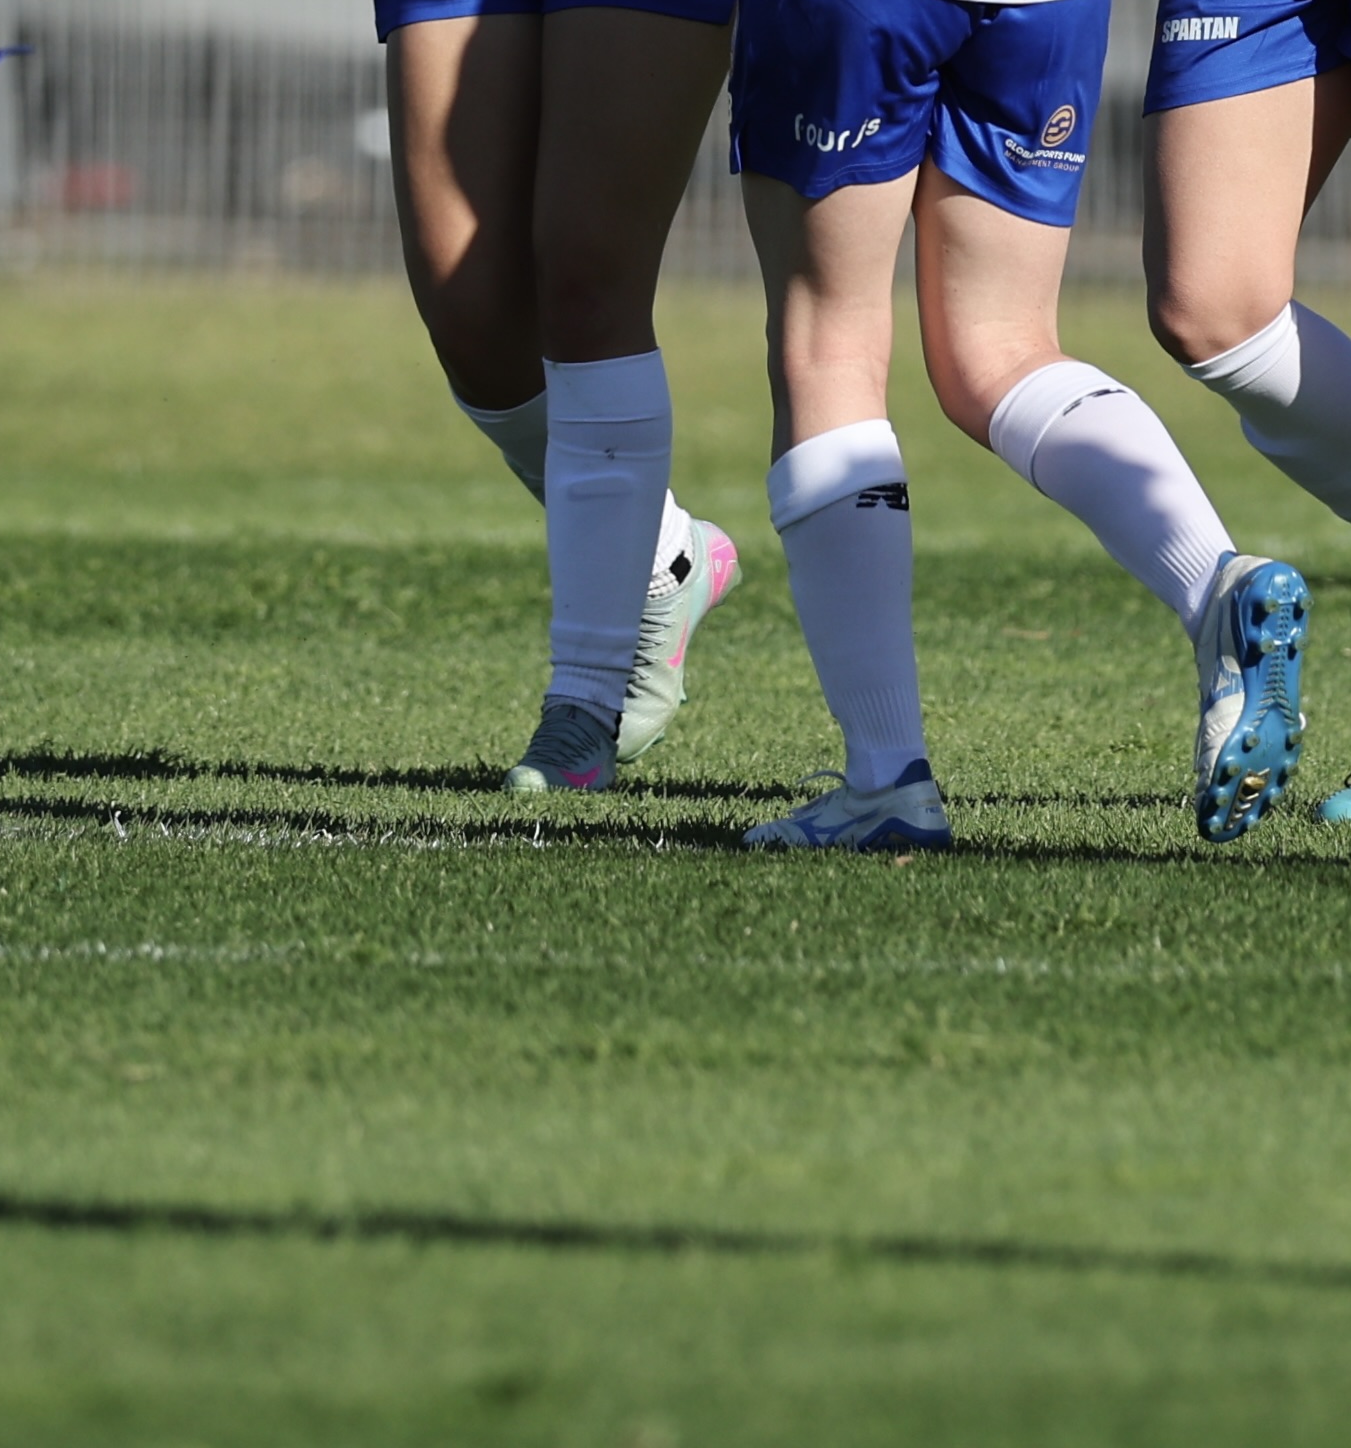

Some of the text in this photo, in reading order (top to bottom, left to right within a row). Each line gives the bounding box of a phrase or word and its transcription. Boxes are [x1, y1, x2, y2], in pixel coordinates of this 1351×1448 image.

[1161, 16, 1239, 44] SPARTAN
[1005, 138, 1035, 159] GLOBA
[1034, 149, 1064, 161] SPORTS
[1053, 162, 1080, 172] GROUP
